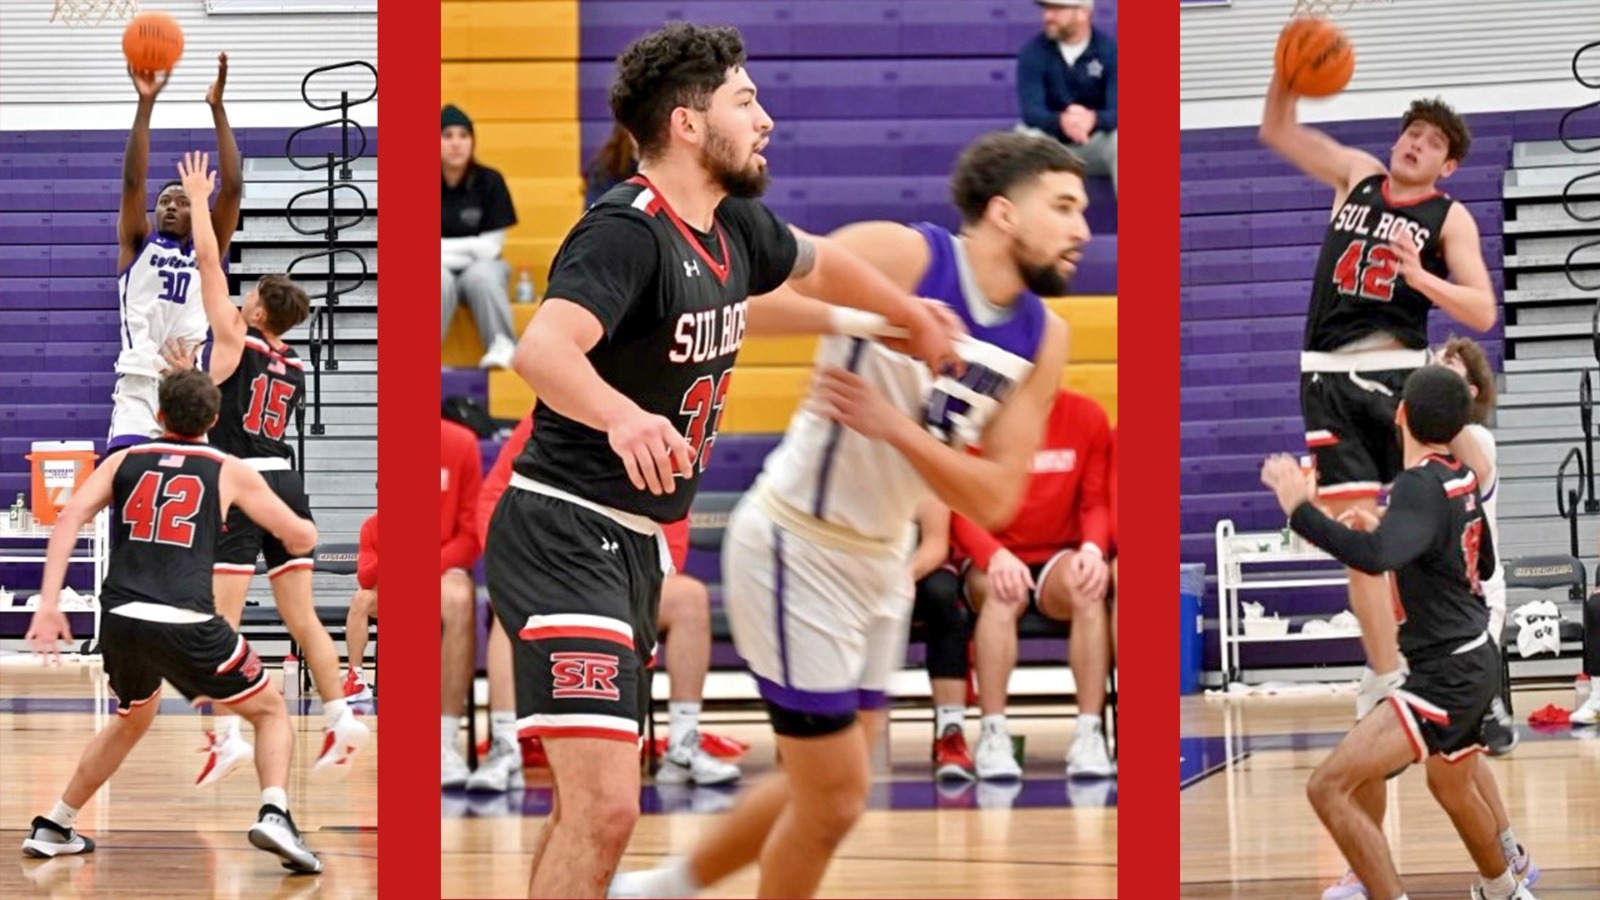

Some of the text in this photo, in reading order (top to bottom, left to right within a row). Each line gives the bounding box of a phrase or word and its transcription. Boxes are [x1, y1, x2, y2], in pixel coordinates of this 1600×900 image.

[1334, 203, 1431, 252] SUL ROSS
[158, 269, 191, 305] 30
[1332, 238, 1399, 302] 42
[668, 309, 718, 363] SUL
[242, 372, 297, 441] 15
[122, 469, 206, 549] 42
[550, 656, 620, 696] SR
